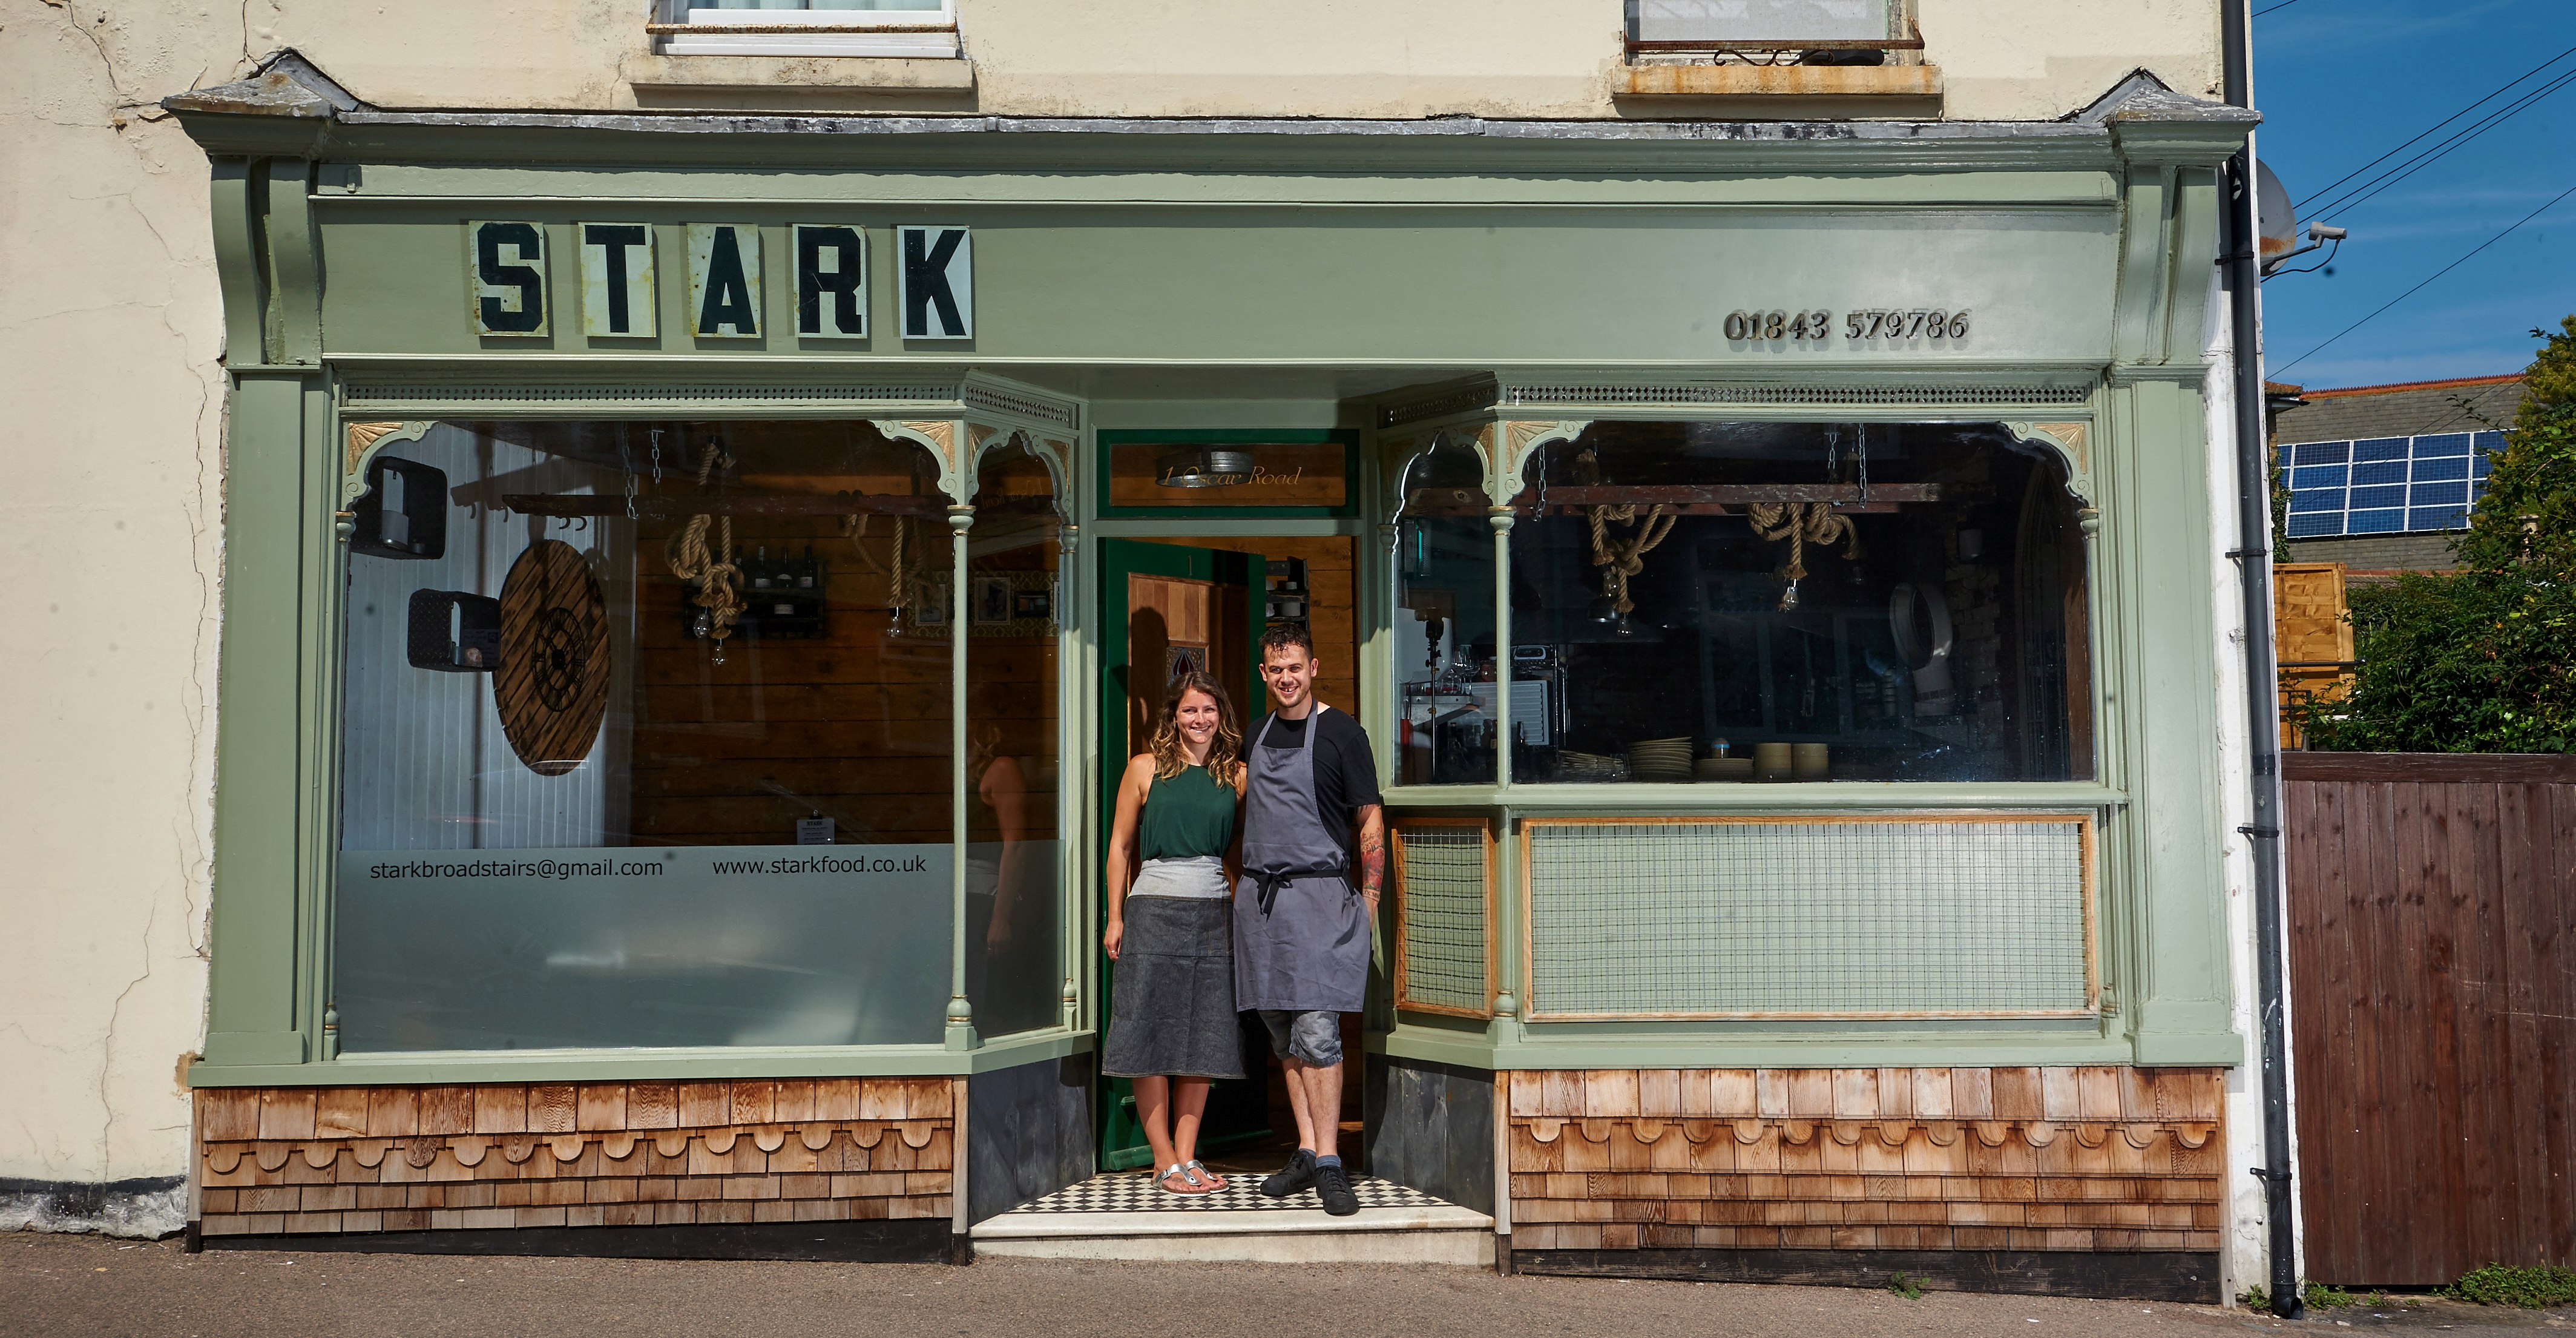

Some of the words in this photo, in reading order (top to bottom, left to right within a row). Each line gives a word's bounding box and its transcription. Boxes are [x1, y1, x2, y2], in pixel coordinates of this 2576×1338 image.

[477, 223, 967, 337] STARK
[1723, 312, 1827, 340] 01843
[1845, 312, 1968, 340] 579786
[1163, 466, 1174, 485] 1
[1181, 466, 1242, 486] Oscar
[1248, 466, 1303, 485] Road
[370, 858, 663, 880] starkbroadstairs@gmail.com
[712, 855, 927, 874] www.starkfood.co.uk
